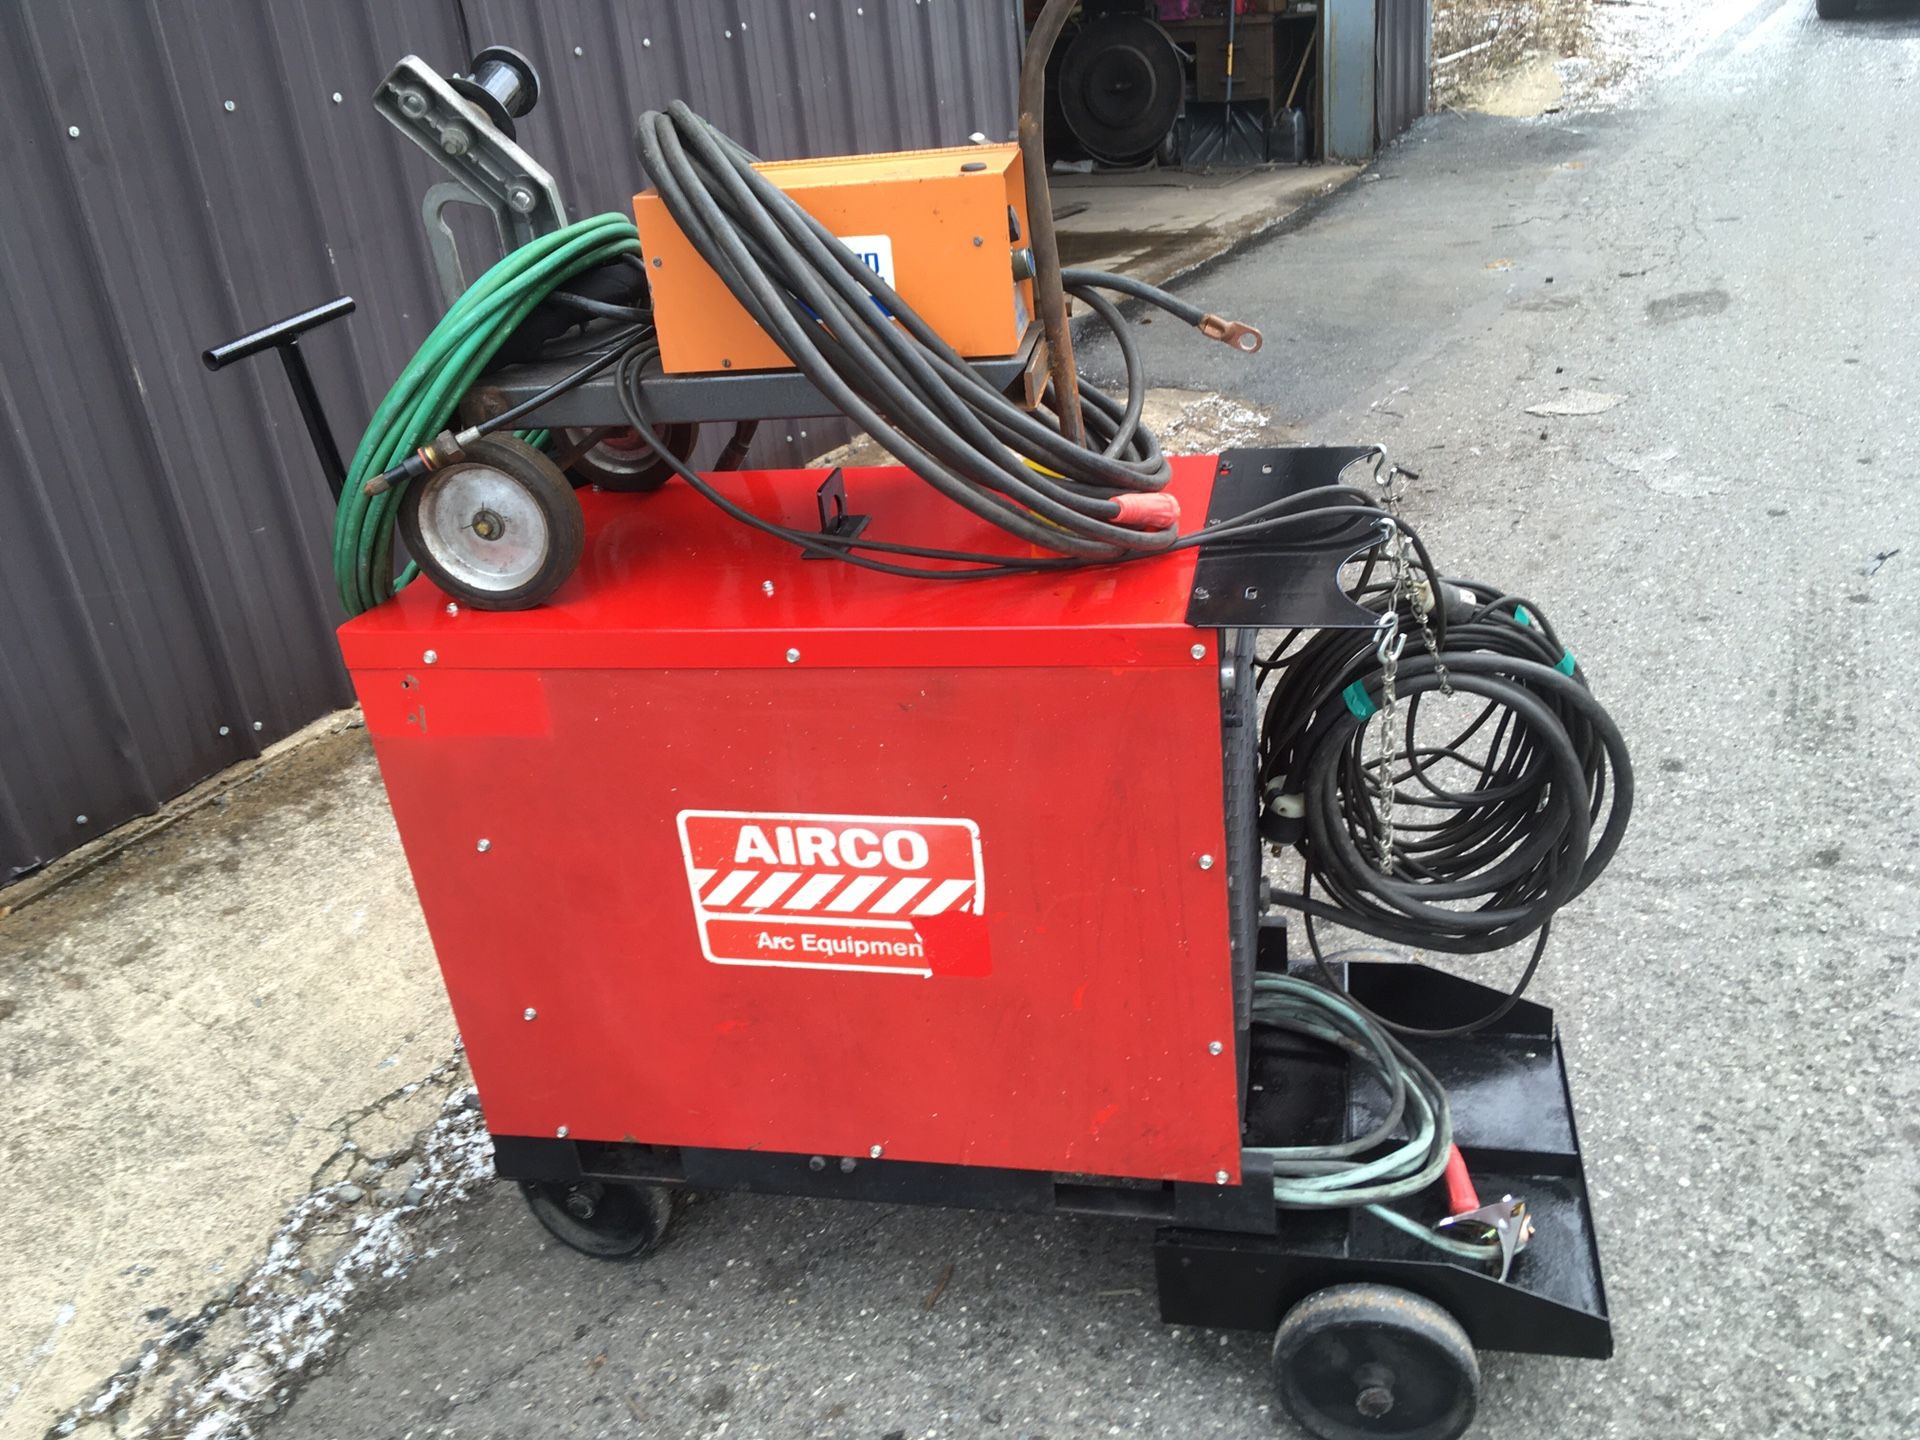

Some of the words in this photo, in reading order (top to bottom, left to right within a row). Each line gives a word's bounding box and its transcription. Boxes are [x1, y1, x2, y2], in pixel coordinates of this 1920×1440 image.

[734, 825, 929, 870] AIRCO
[757, 932, 795, 951] Arc
[801, 933, 924, 958] Equipmen
